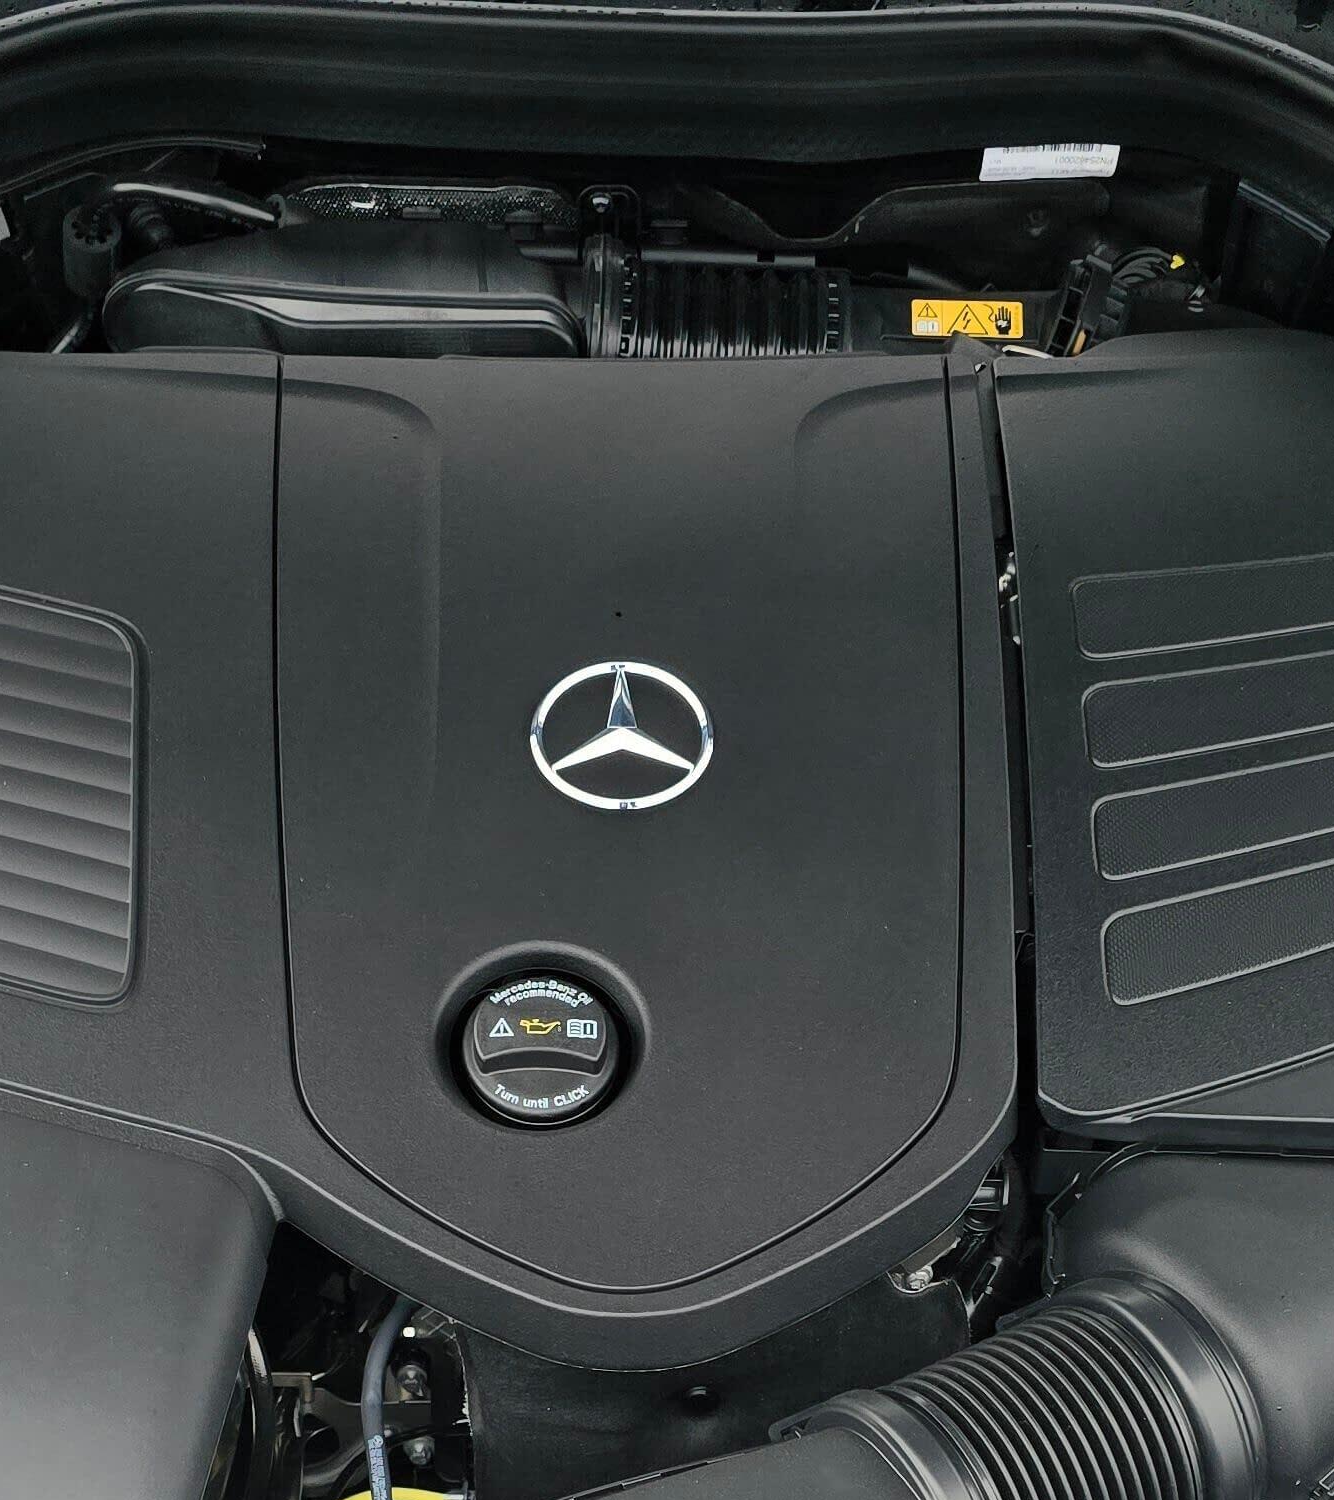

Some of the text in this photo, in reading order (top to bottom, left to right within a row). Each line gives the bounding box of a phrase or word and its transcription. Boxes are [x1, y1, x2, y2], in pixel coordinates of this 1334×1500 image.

[489, 978, 578, 1005] Mercedes-Benz
[504, 988, 581, 1008] recommended
[494, 1083, 590, 1109] Turn until CLICK
